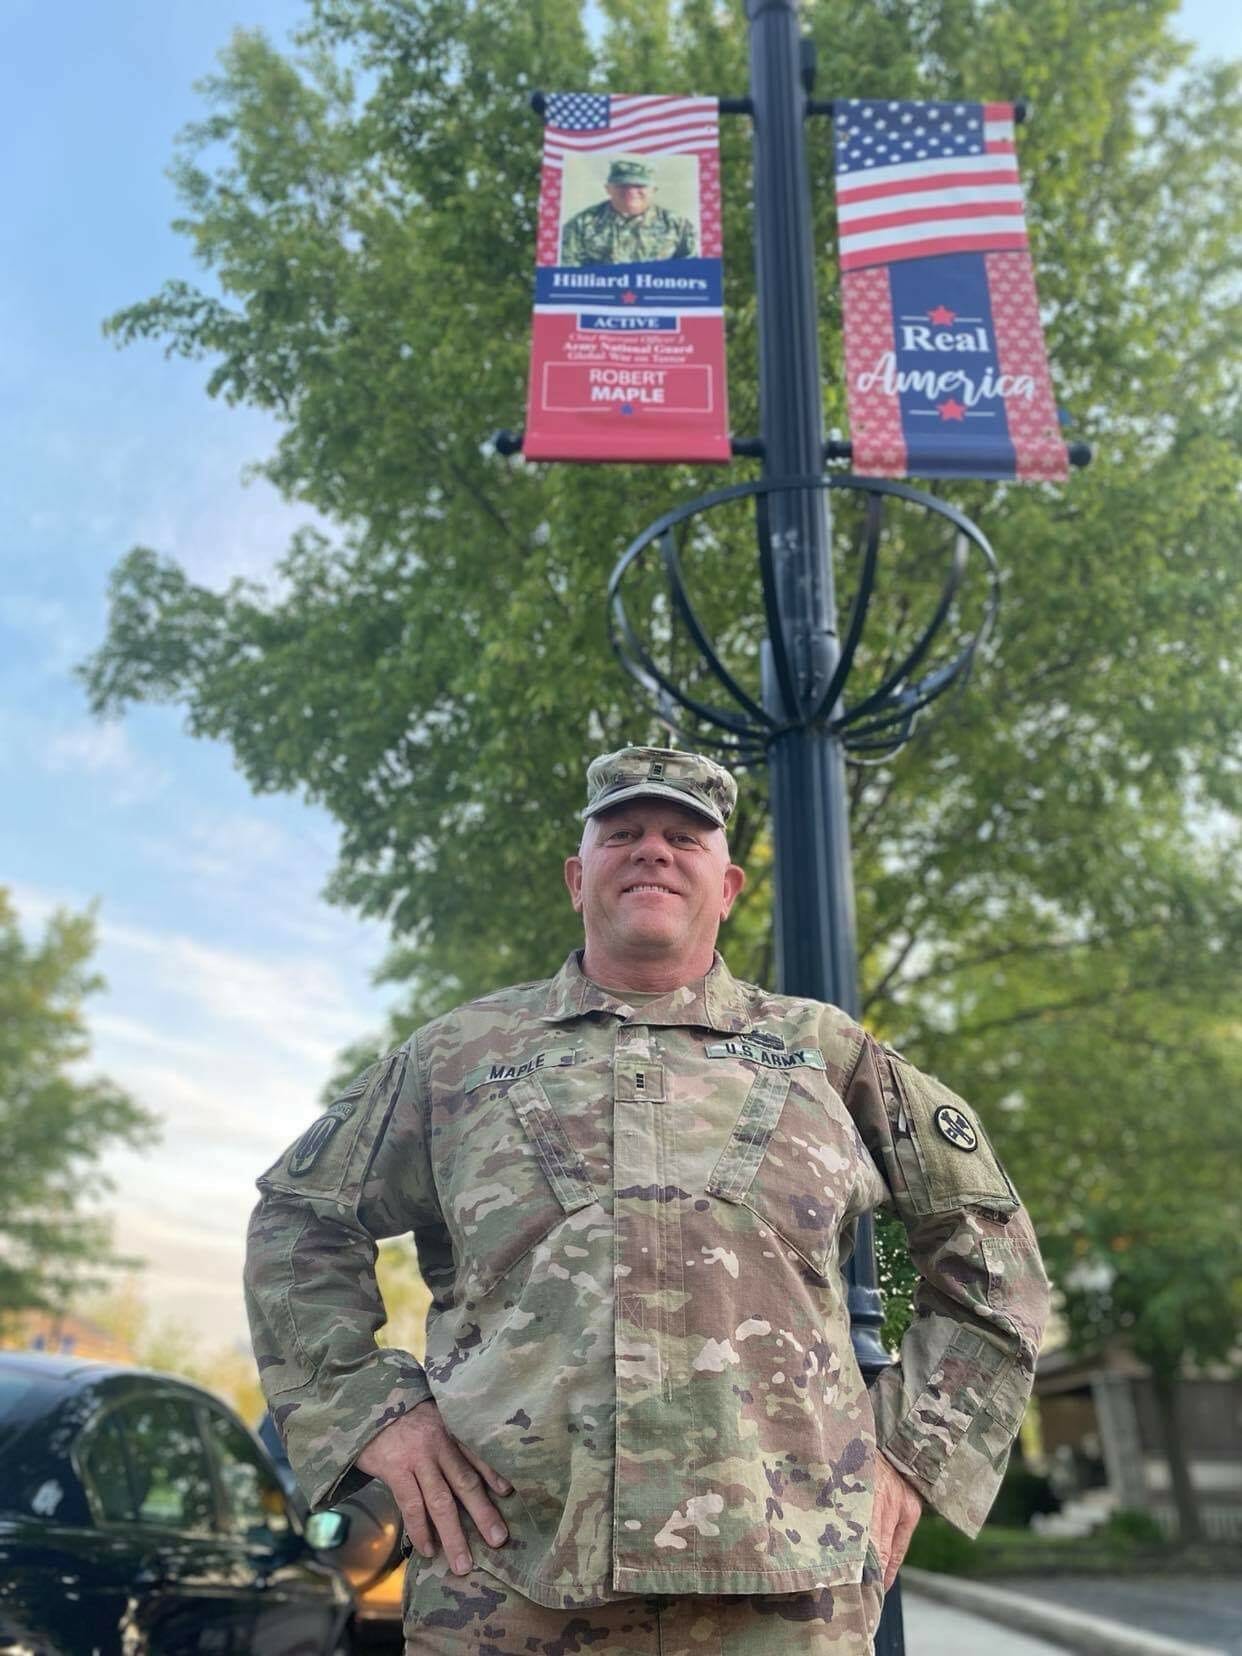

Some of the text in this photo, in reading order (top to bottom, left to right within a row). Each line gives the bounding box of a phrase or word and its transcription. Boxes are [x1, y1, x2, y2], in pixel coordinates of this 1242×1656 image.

[553, 273, 707, 289] Hilliard Honors
[594, 317, 659, 328] ACTIVE
[901, 325, 989, 352] Real
[601, 342, 651, 354] National
[654, 344, 695, 354] Guard
[589, 368, 666, 385] ROBERT
[857, 351, 1035, 407] America
[591, 386, 665, 403] MAPLE
[489, 1053, 545, 1079] MAPLE
[761, 1051, 806, 1066] ARMY
